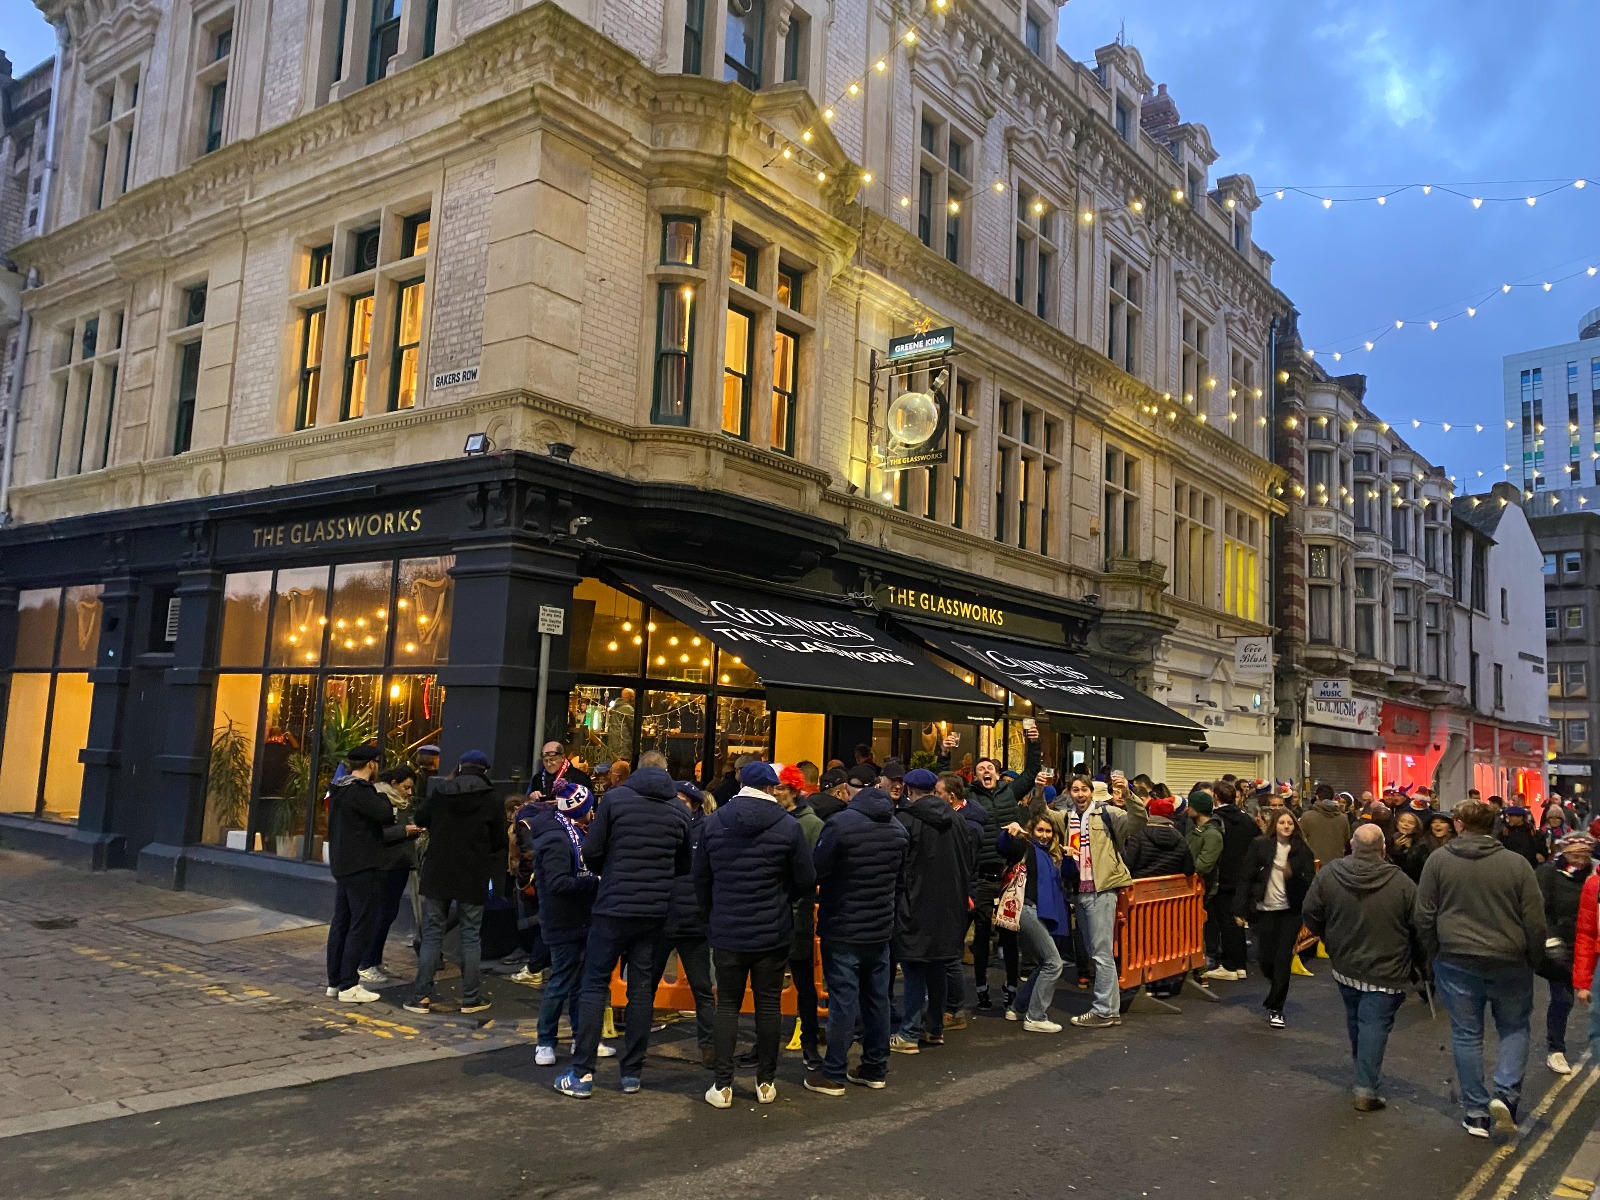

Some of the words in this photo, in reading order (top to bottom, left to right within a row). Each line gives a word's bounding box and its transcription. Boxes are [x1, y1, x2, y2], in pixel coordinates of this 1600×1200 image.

[895, 341, 923, 353] GREENE
[925, 335, 945, 346] KING
[435, 372, 460, 387] BAKERS
[462, 368, 478, 381] ROW
[902, 453, 943, 464] GLASSWORKS
[253, 525, 285, 548] THE
[290, 508, 422, 544] GLASSWORKS
[888, 586, 916, 608] THE
[919, 593, 1004, 626] GLASSWORKS
[710, 600, 875, 641] GUINNESS
[1239, 653, 1268, 663] Blush
